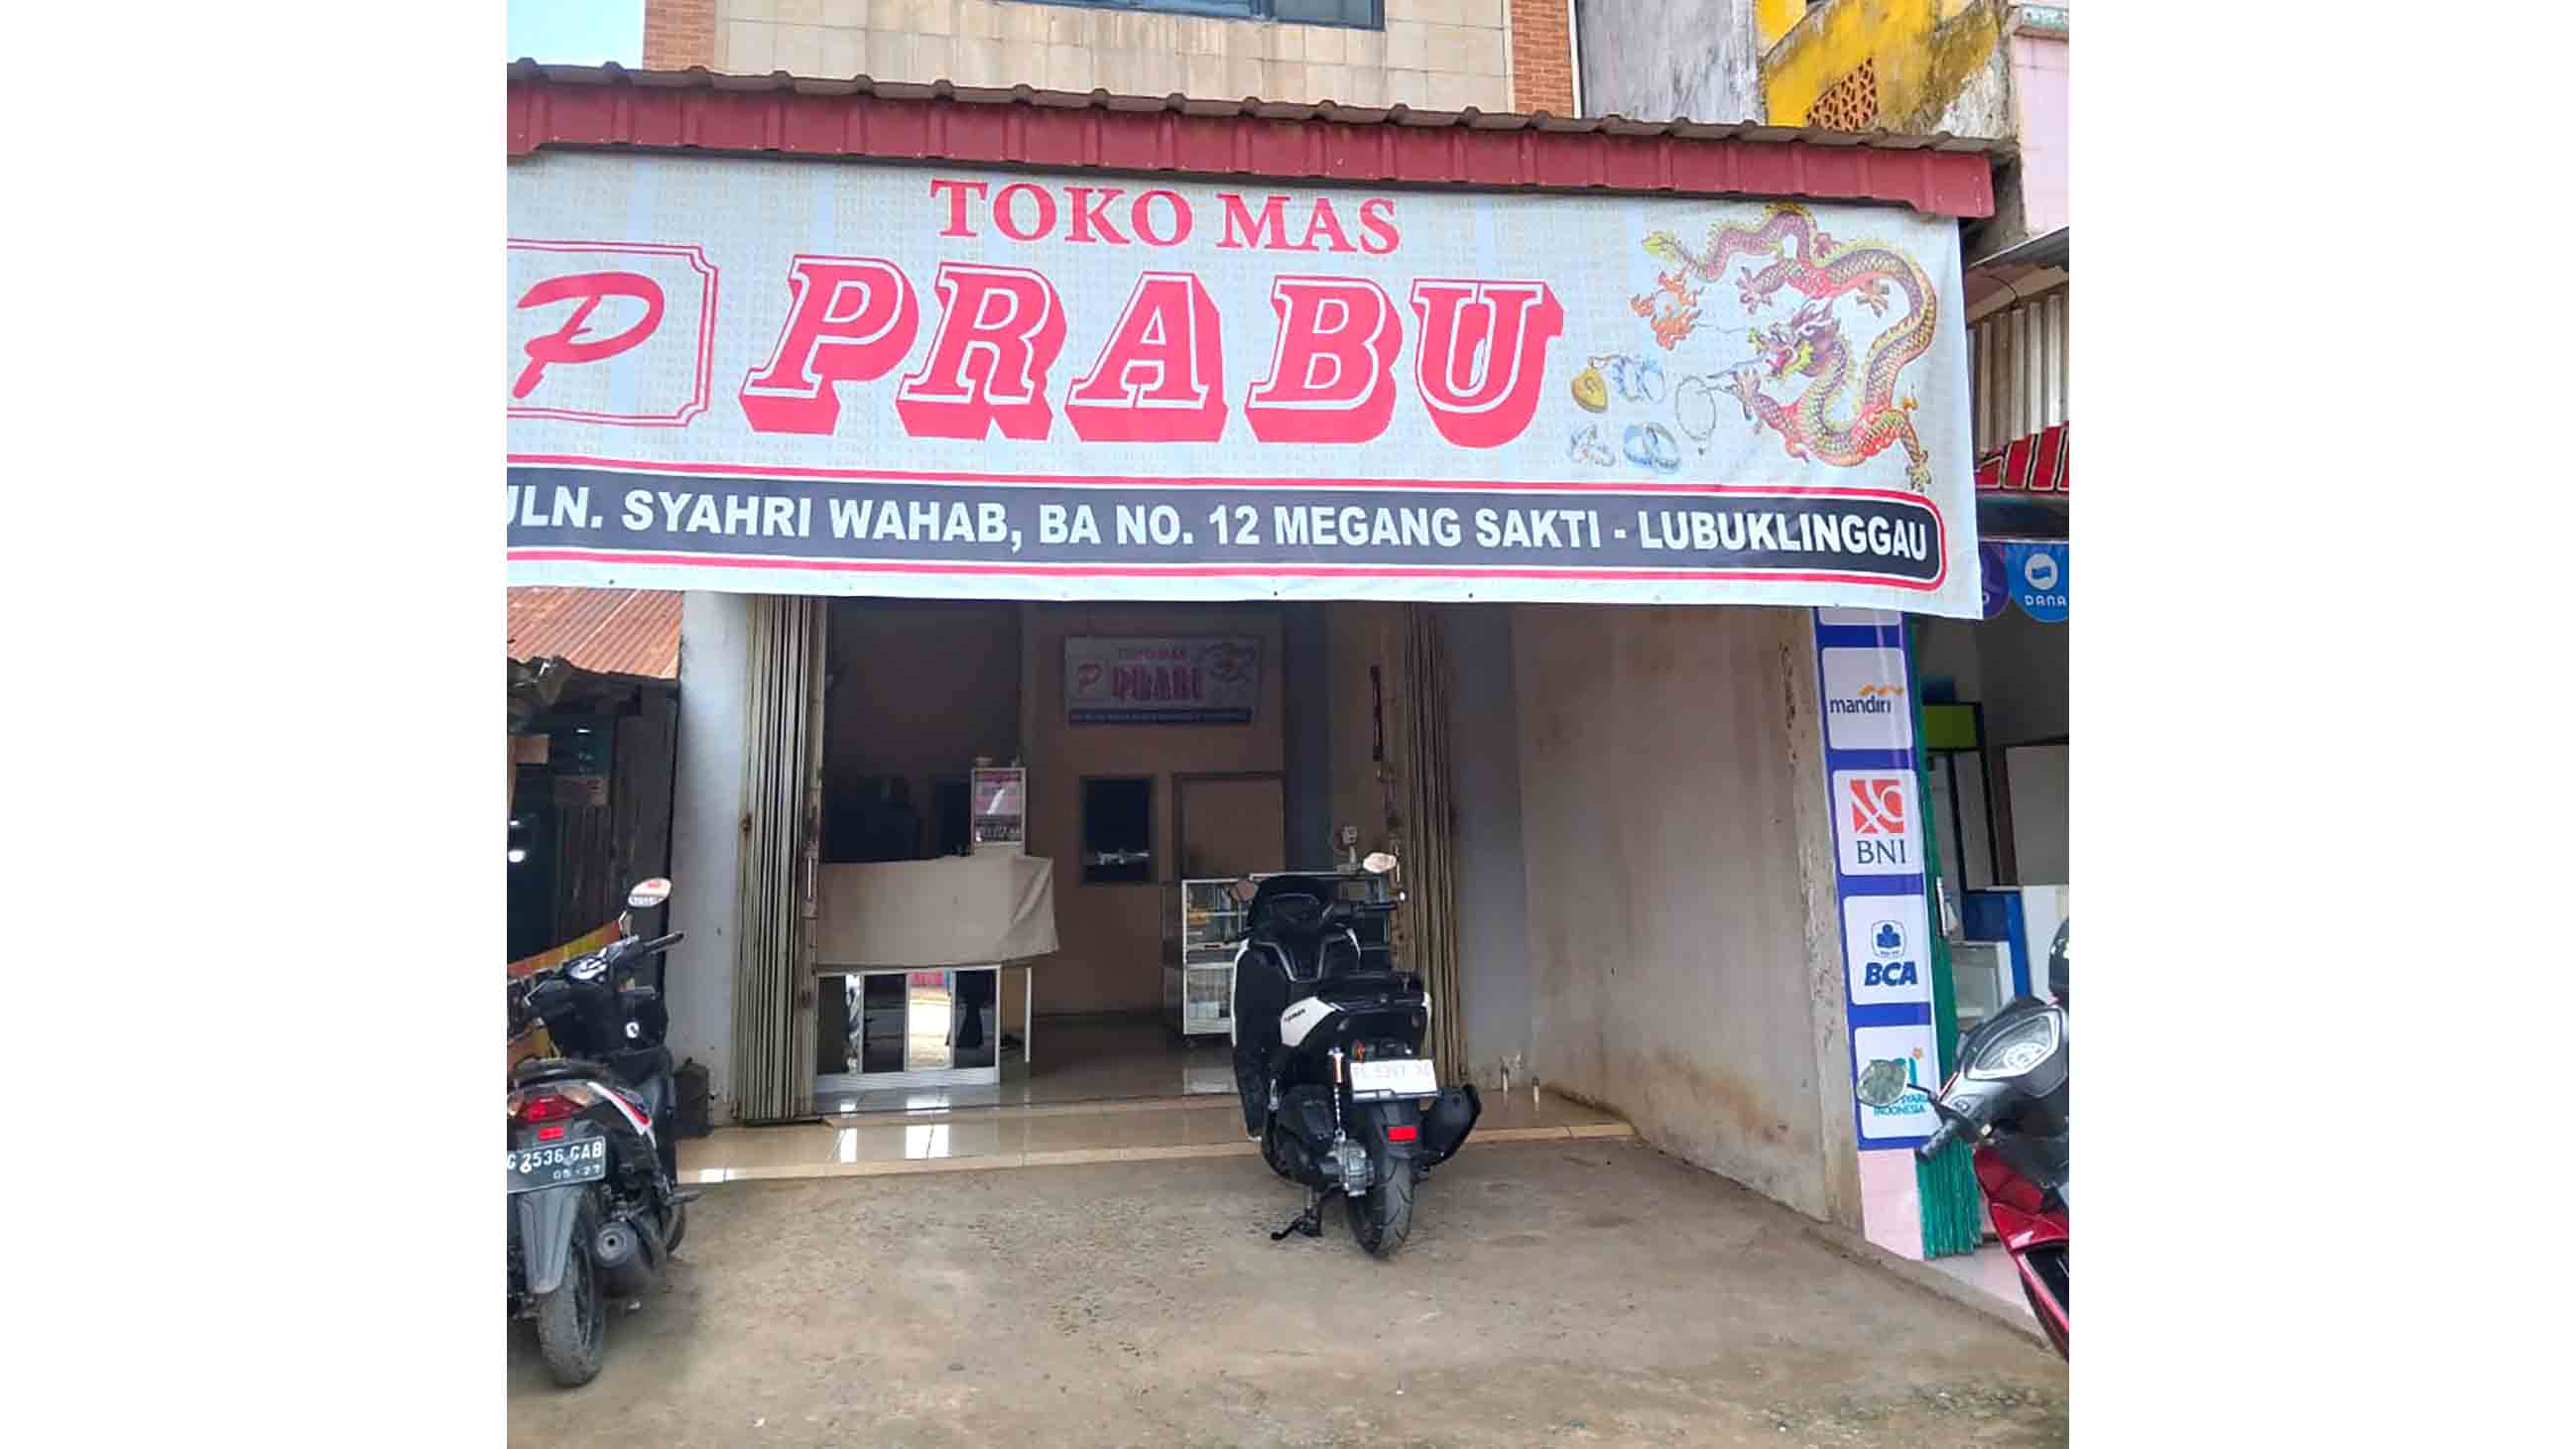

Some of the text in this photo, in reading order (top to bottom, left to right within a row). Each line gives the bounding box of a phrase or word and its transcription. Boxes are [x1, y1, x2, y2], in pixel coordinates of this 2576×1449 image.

[929, 179, 1402, 254] TOKO MAS
[512, 271, 666, 399] P
[739, 254, 1565, 449] PRABU
[622, 490, 811, 539] SYAHRI
[828, 500, 1022, 553] WAHAB,
[1040, 504, 1101, 544] BA
[1118, 506, 1193, 544] NO.
[1209, 505, 1261, 545] 12
[1275, 506, 1460, 548] MEGANG
[1475, 508, 1601, 548] SAKTI
[1638, 511, 1928, 560] LUBUKLINGGAU
[1830, 695, 1891, 714] mandiri
[1857, 840, 1905, 865] BNI
[1865, 961, 1918, 987] BCA
